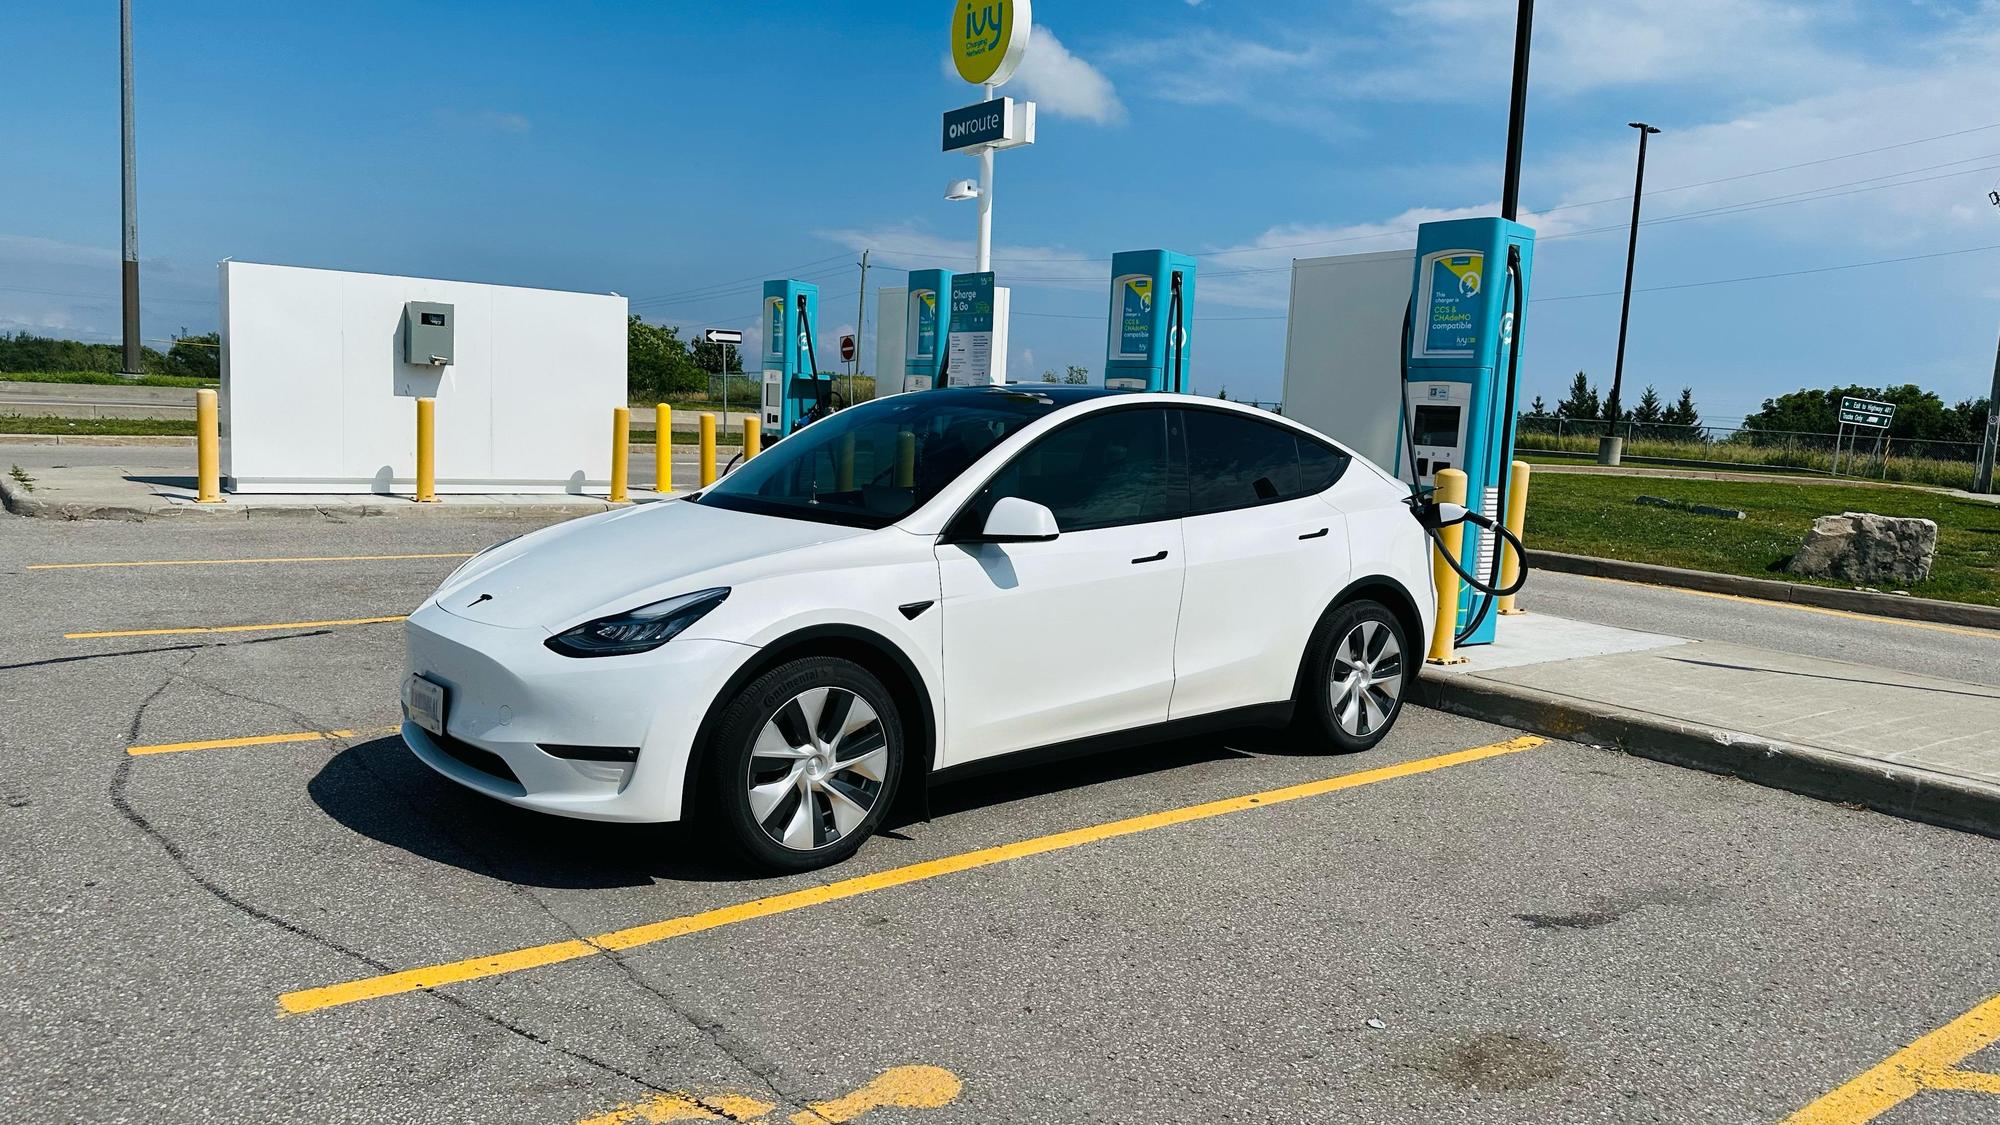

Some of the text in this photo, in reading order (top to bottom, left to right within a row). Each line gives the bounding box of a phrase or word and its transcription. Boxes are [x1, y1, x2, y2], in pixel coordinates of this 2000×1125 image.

[966, 2, 1003, 51] ivy
[953, 290, 977, 301] Charge
[953, 302, 969, 311] & Go
[1432, 322, 1472, 331] compatible
[1867, 404, 1883, 413] Highway
